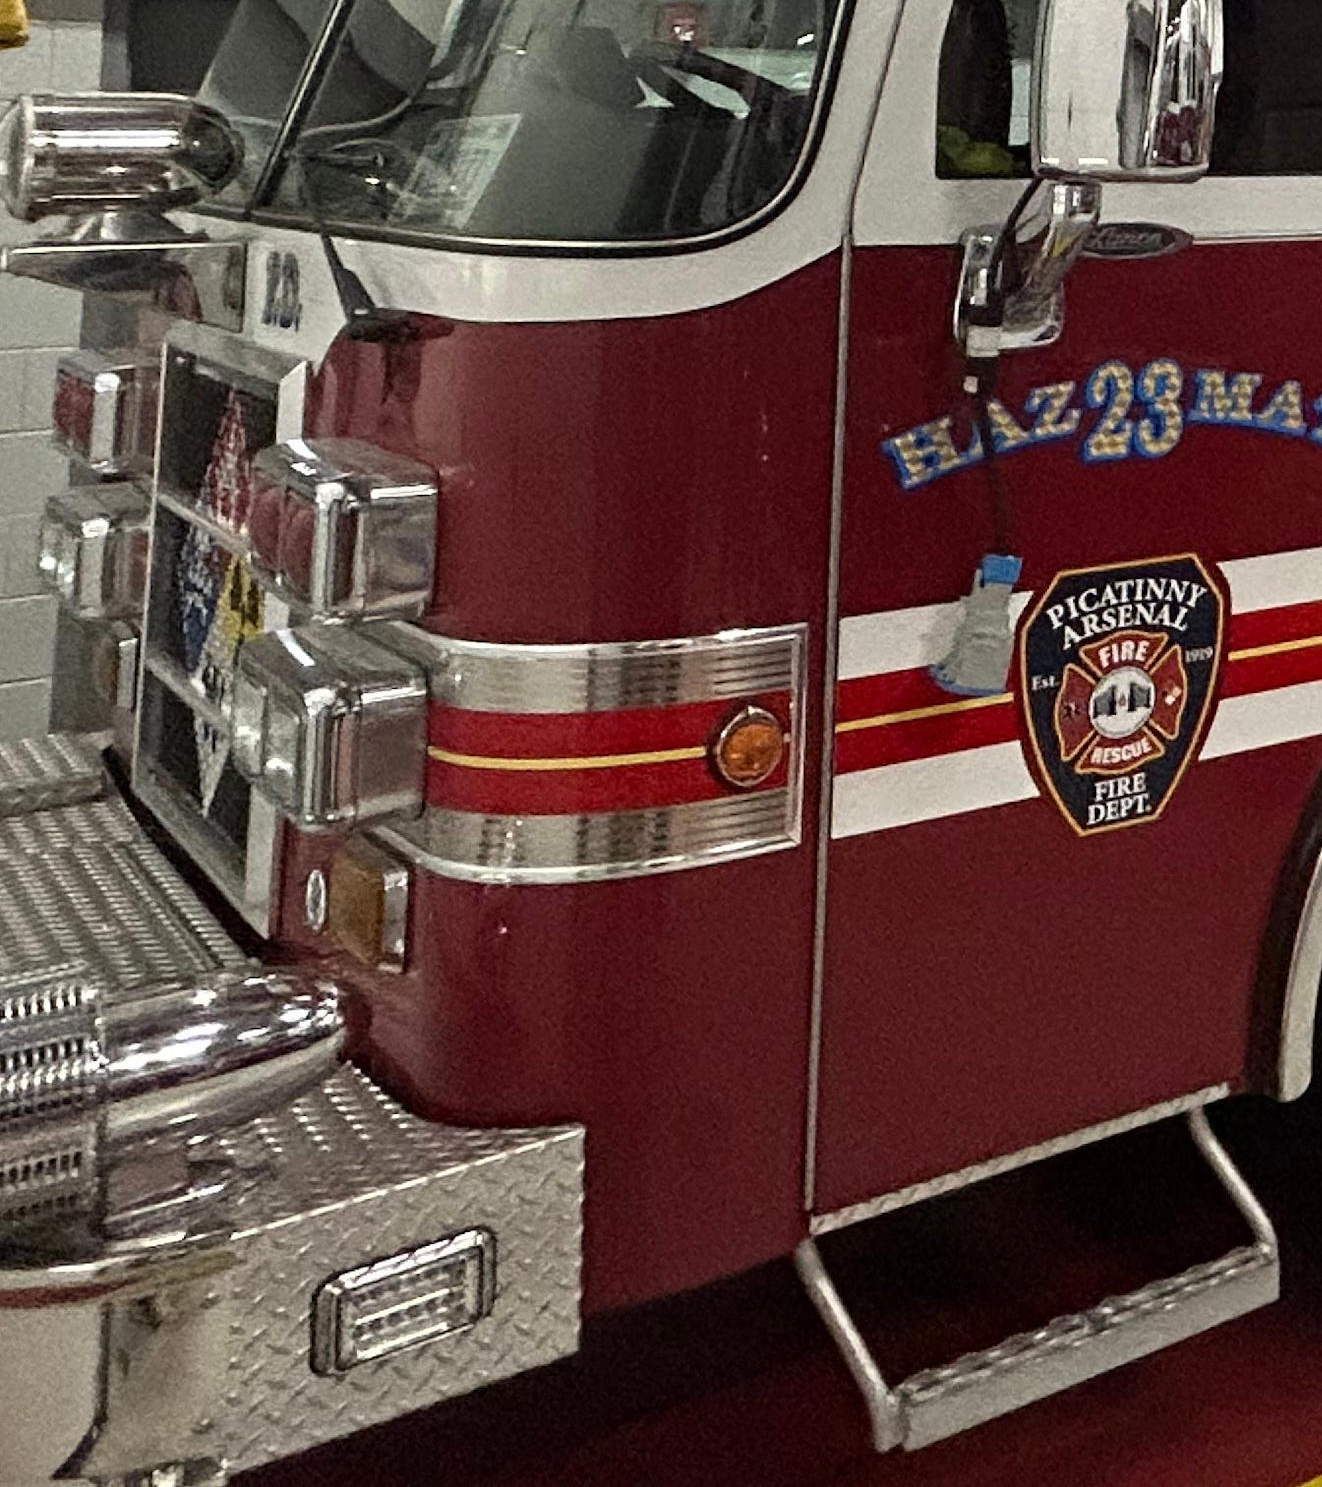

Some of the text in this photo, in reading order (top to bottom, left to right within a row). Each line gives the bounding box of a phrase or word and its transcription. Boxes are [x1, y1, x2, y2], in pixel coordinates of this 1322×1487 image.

[1081, 357, 1186, 466] 23
[1045, 576, 1209, 630] PICATINNY
[1061, 602, 1190, 651] ARSENAL
[1097, 638, 1151, 669] FIRE
[1090, 737, 1154, 765] RESCUE
[1093, 771, 1148, 803] FIRE
[1086, 792, 1153, 826] DEPT.
